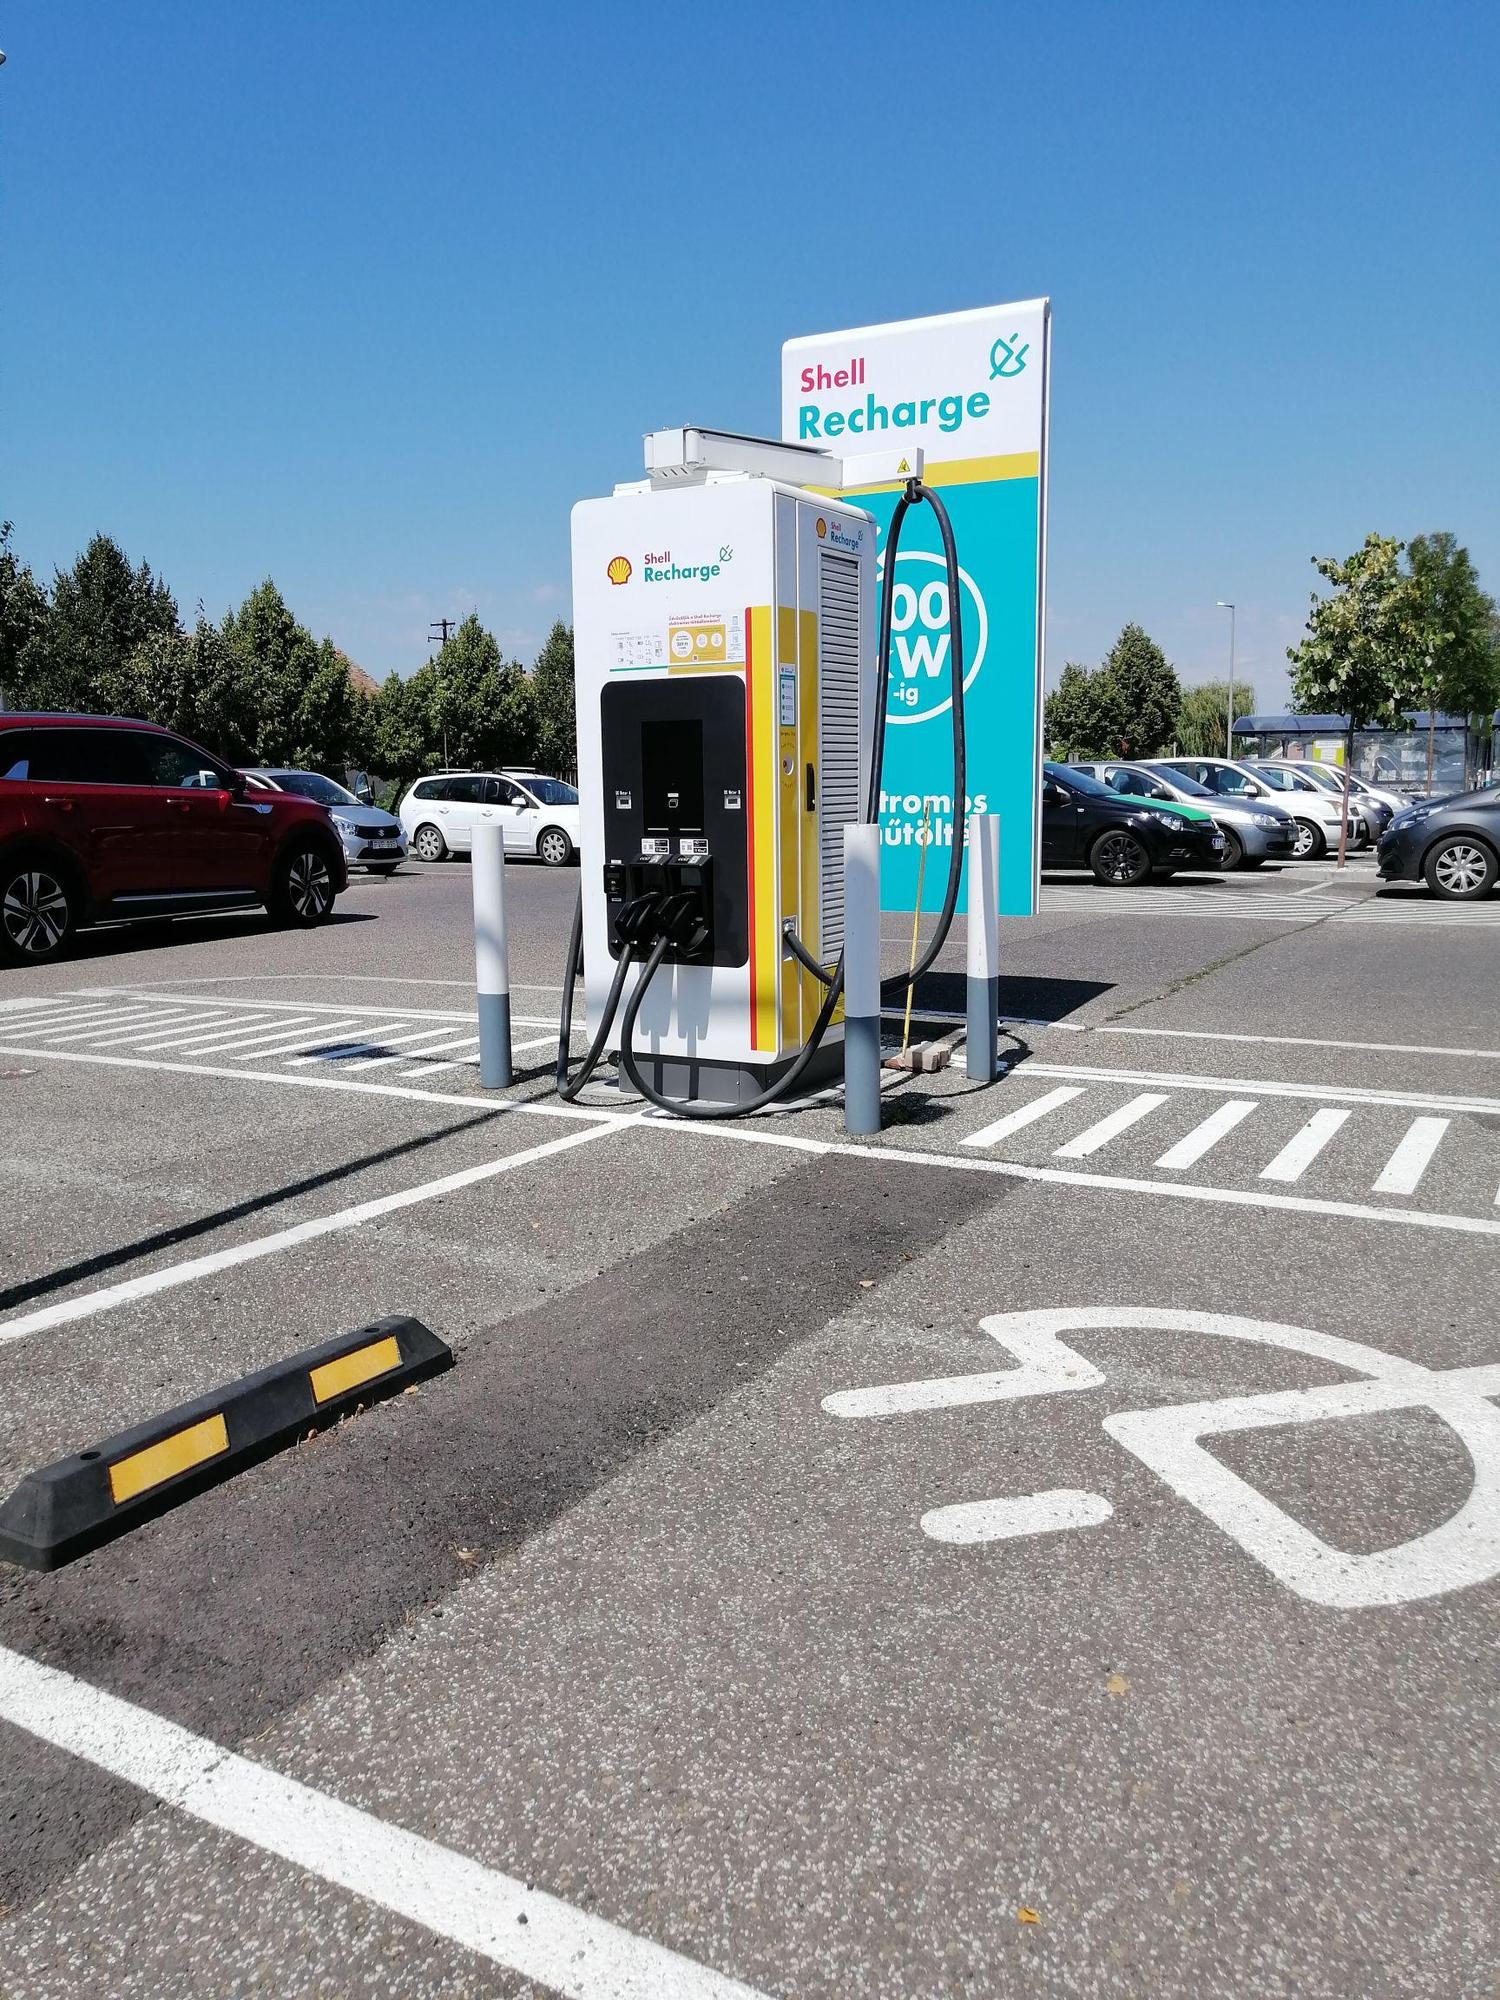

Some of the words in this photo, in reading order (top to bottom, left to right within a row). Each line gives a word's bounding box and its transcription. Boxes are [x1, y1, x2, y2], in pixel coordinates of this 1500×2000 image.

[801, 358, 864, 392] Shell
[800, 392, 990, 439] Recharge
[831, 521, 841, 531] Shell
[831, 530, 859, 550] Recharge
[644, 551, 671, 564] Shell
[644, 563, 721, 582] Recharge
[893, 682, 919, 707] -ig
